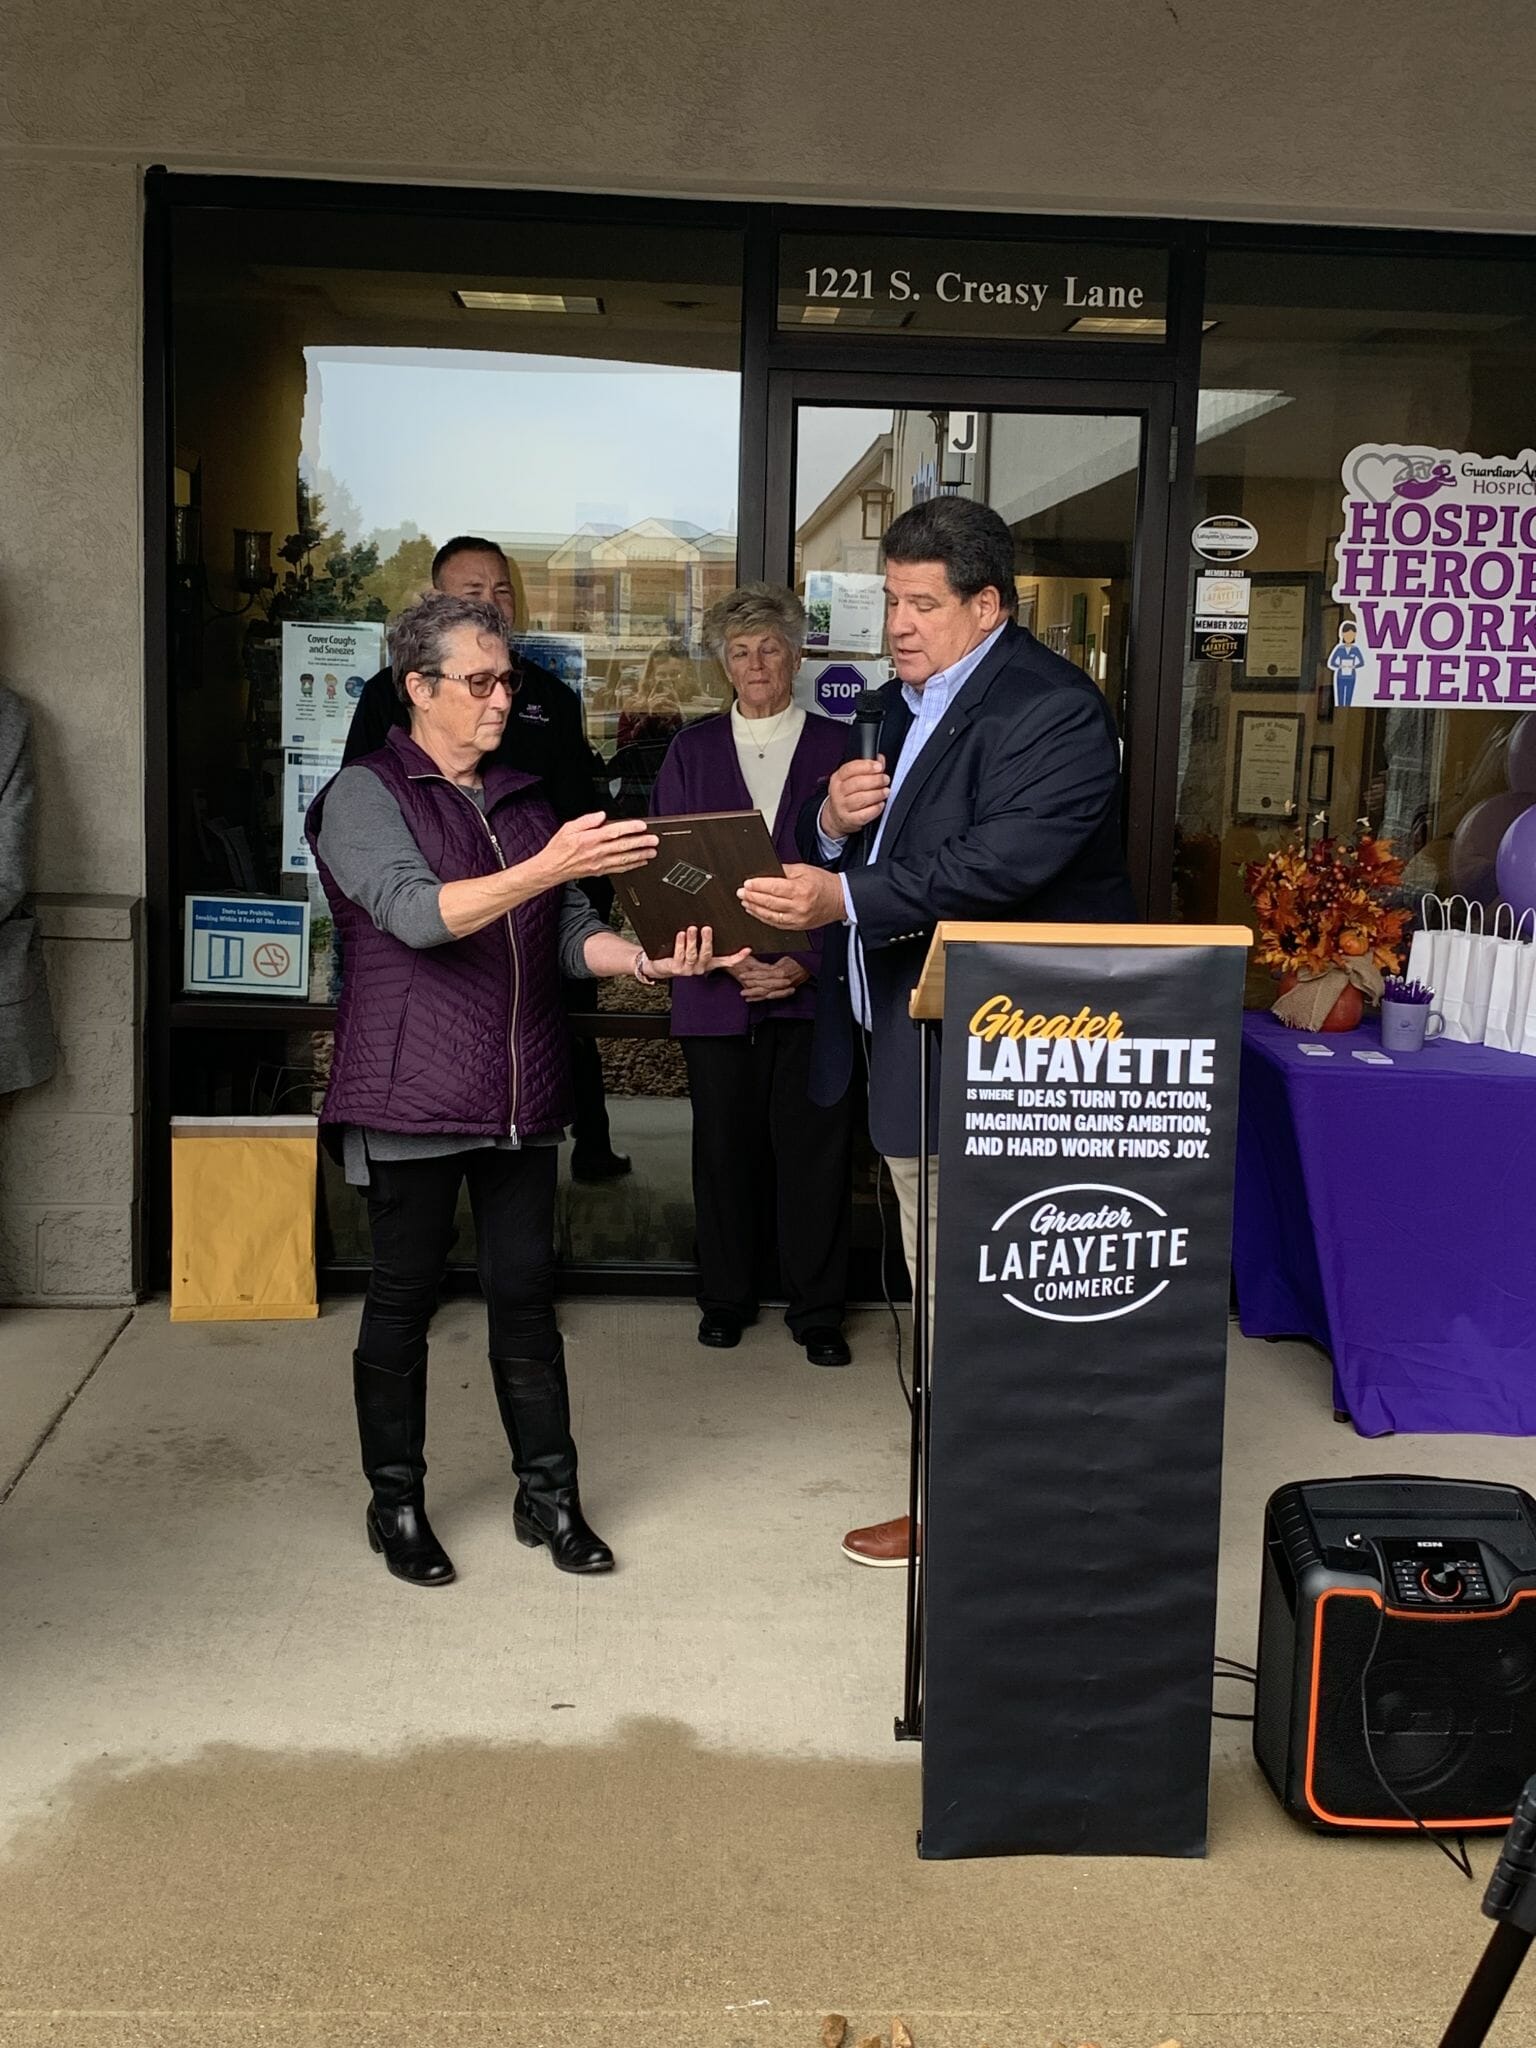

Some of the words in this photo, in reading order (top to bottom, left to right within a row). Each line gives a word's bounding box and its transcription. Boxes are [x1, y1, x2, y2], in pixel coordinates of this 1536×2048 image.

[805, 266, 874, 300] 1221
[889, 270, 920, 301] S.
[936, 271, 1049, 311] Creasy
[1064, 276, 1144, 308] Lane
[951, 414, 975, 451] J
[1473, 479, 1536, 496] HOSPIC
[1196, 620, 1228, 630] MEMBER
[1228, 621, 1248, 630] 2022
[1358, 601, 1536, 652] WORK
[307, 633, 329, 644] Cover
[329, 635, 357, 648] Coughs
[309, 644, 324, 654] and
[325, 645, 355, 656] Sneezes
[820, 682, 861, 698] STOP
[1373, 653, 1536, 704] HERE
[968, 994, 1125, 1042] Greater
[967, 1036, 1216, 1085] LAFAYETTE
[966, 1088, 977, 1100] IS
[978, 1088, 1015, 1101] WHERE
[1017, 1088, 1067, 1108] IDEAS
[1070, 1089, 1116, 1109] TURN
[1119, 1090, 1141, 1109] TO
[1144, 1090, 1212, 1111] ACTION,
[965, 1112, 1071, 1131] IMAGINATION
[1074, 1114, 1124, 1133] GAINS
[1126, 1115, 1212, 1135] AMBITION,
[965, 1136, 1004, 1156] AND
[1007, 1136, 1058, 1157] HARD
[1061, 1138, 1115, 1158] WORK
[1118, 1138, 1170, 1159] FINDS
[1173, 1139, 1210, 1159] JOY.
[1030, 1203, 1133, 1236] Greater
[978, 1228, 1189, 1283] LAFAYETTE
[1033, 1275, 1135, 1302] COMMERCE
